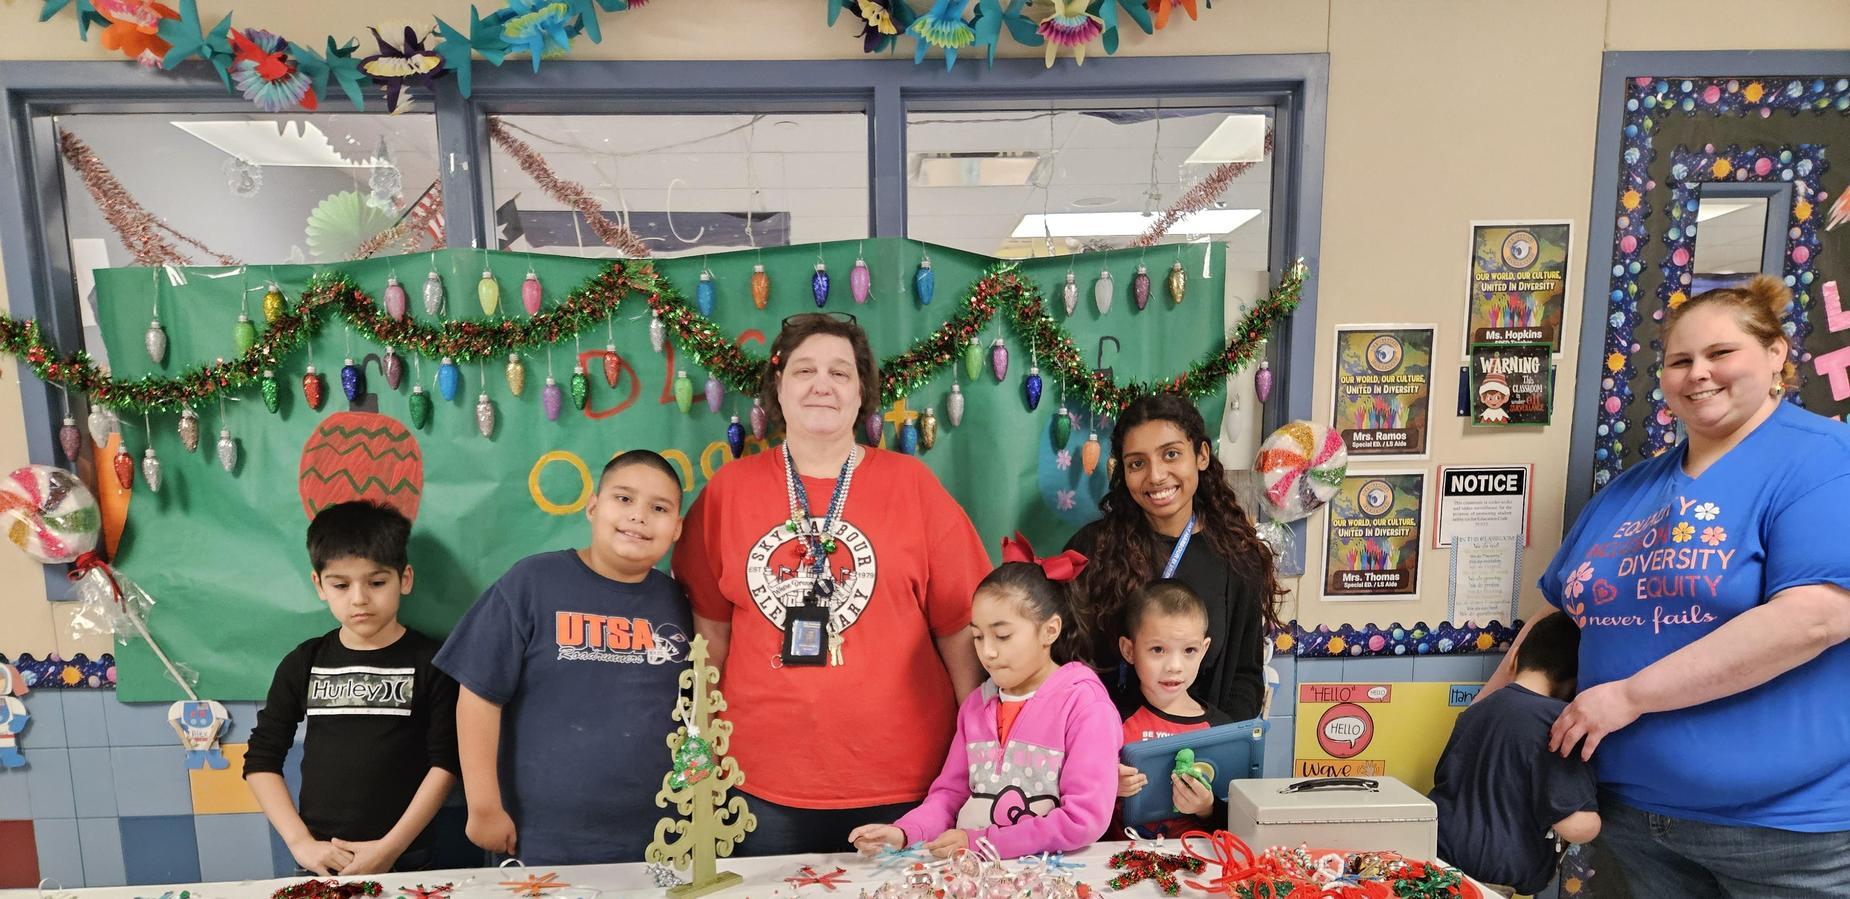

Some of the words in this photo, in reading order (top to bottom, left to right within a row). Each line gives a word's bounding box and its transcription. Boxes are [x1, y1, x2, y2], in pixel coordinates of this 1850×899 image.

[1475, 272, 1490, 281] OUR
[1517, 271, 1531, 280] OUR
[1481, 283, 1507, 292] UNITED
[1509, 282, 1517, 291] IN
[1519, 281, 1555, 291] DIVERSITY
[1486, 331, 1503, 340] Ms.
[1506, 330, 1543, 341] Hopkins
[1480, 356, 1541, 374] WARNING
[1340, 376, 1355, 384] OUR
[1381, 375, 1396, 383] OUR
[1522, 375, 1535, 384] This
[1346, 385, 1372, 394] UNITED
[1374, 385, 1382, 394] IN
[1383, 385, 1420, 394] DIVERSITY
[1512, 384, 1543, 393] CLASSROOM
[1353, 432, 1373, 440] Mrs.
[1376, 432, 1407, 440] Ramos
[1451, 475, 1518, 492] NOTICE
[1333, 519, 1347, 527] OUR
[1373, 518, 1387, 526] OUR
[1338, 529, 1364, 537] UNITED
[1365, 528, 1373, 536] IN
[1374, 528, 1410, 537] DIVERSITY
[752, 530, 783, 561] SKY
[793, 520, 872, 567] ABOUR
[1618, 549, 1736, 577] DIVERSITY
[1342, 573, 1362, 581] Mrs.
[1365, 572, 1400, 581] Thomas
[1637, 575, 1724, 600] EQUITY
[1589, 615, 1645, 626] never
[1652, 605, 1718, 634] fails
[556, 611, 656, 653] UTSA
[557, 647, 645, 664] Roadrunners
[312, 678, 383, 701] Hurley
[1142, 730, 1154, 738] BE
[1330, 722, 1361, 736] HELLO
[1302, 762, 1352, 778] Wave
